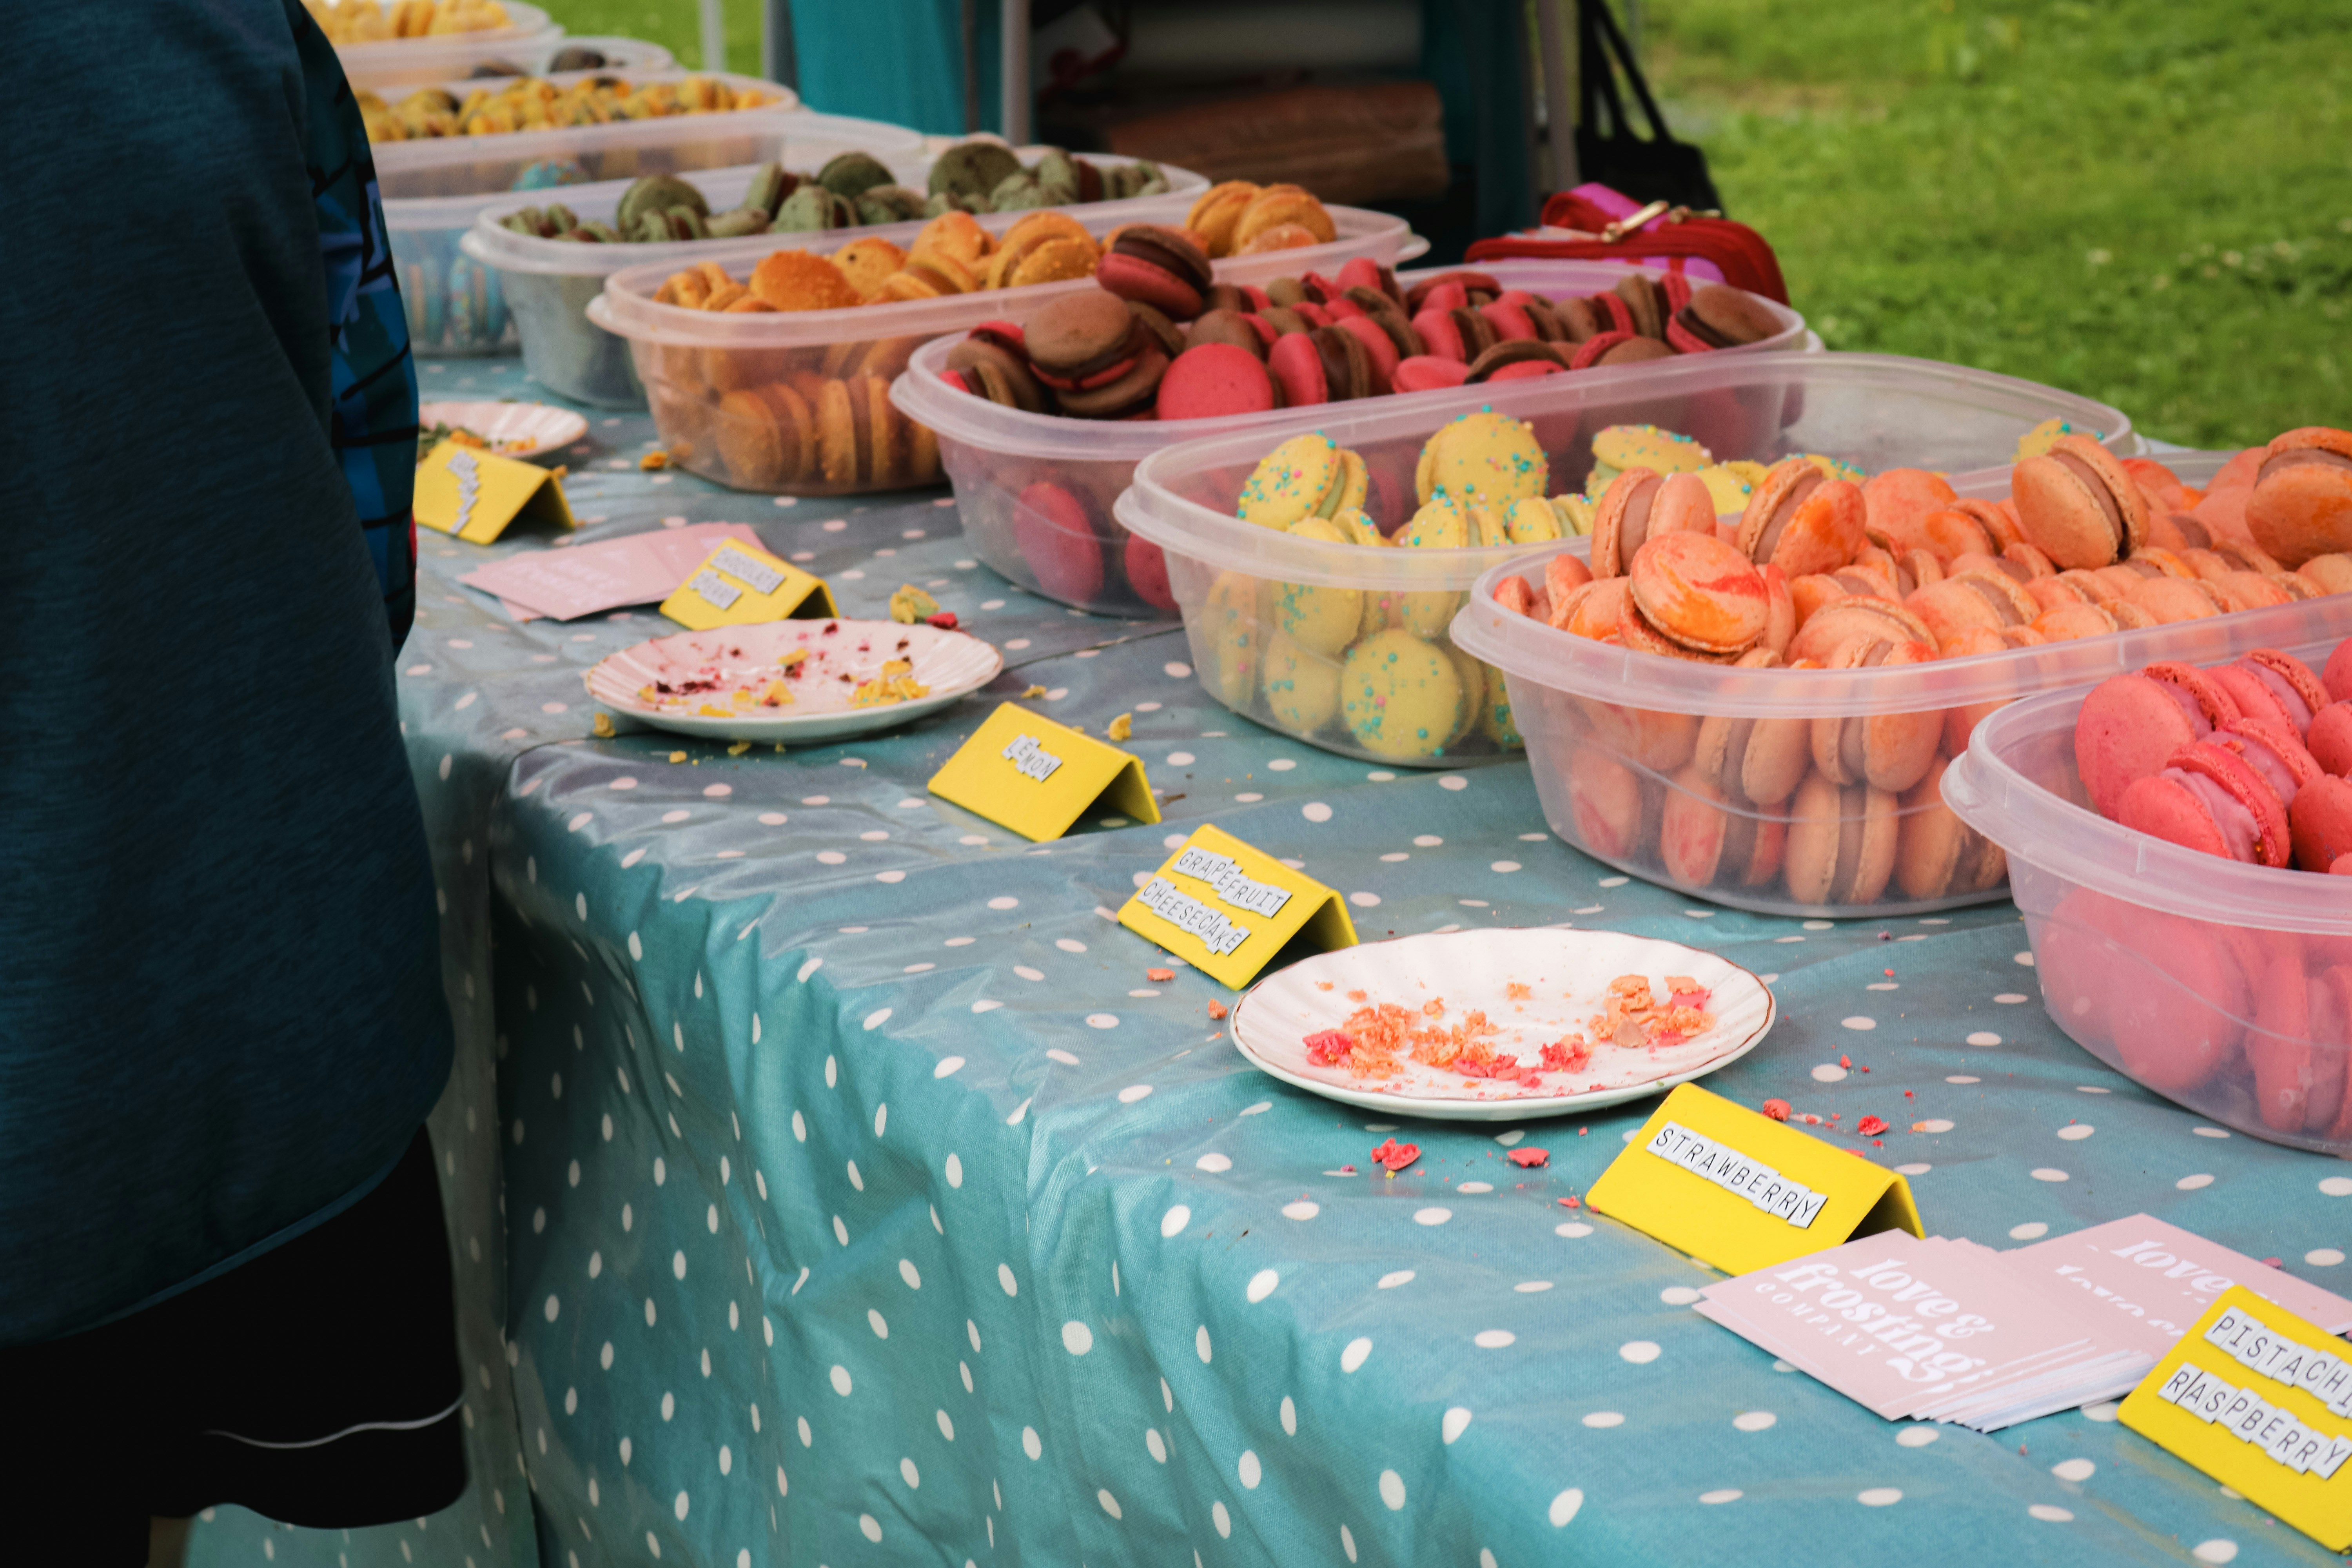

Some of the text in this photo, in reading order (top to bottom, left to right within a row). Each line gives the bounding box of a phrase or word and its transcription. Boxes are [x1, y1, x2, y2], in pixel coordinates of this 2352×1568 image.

[1008, 739, 1055, 776] LEMON
[1143, 881, 1242, 949] CHEESECAKE
[1179, 851, 1284, 910] GRAPEFRUIT
[1656, 1127, 1818, 1219] STRAWBERRY
[1755, 1282, 1880, 1356] COMPANY
[1774, 1263, 1987, 1382] frosting
[2167, 1370, 2347, 1466] RASPBERRY
